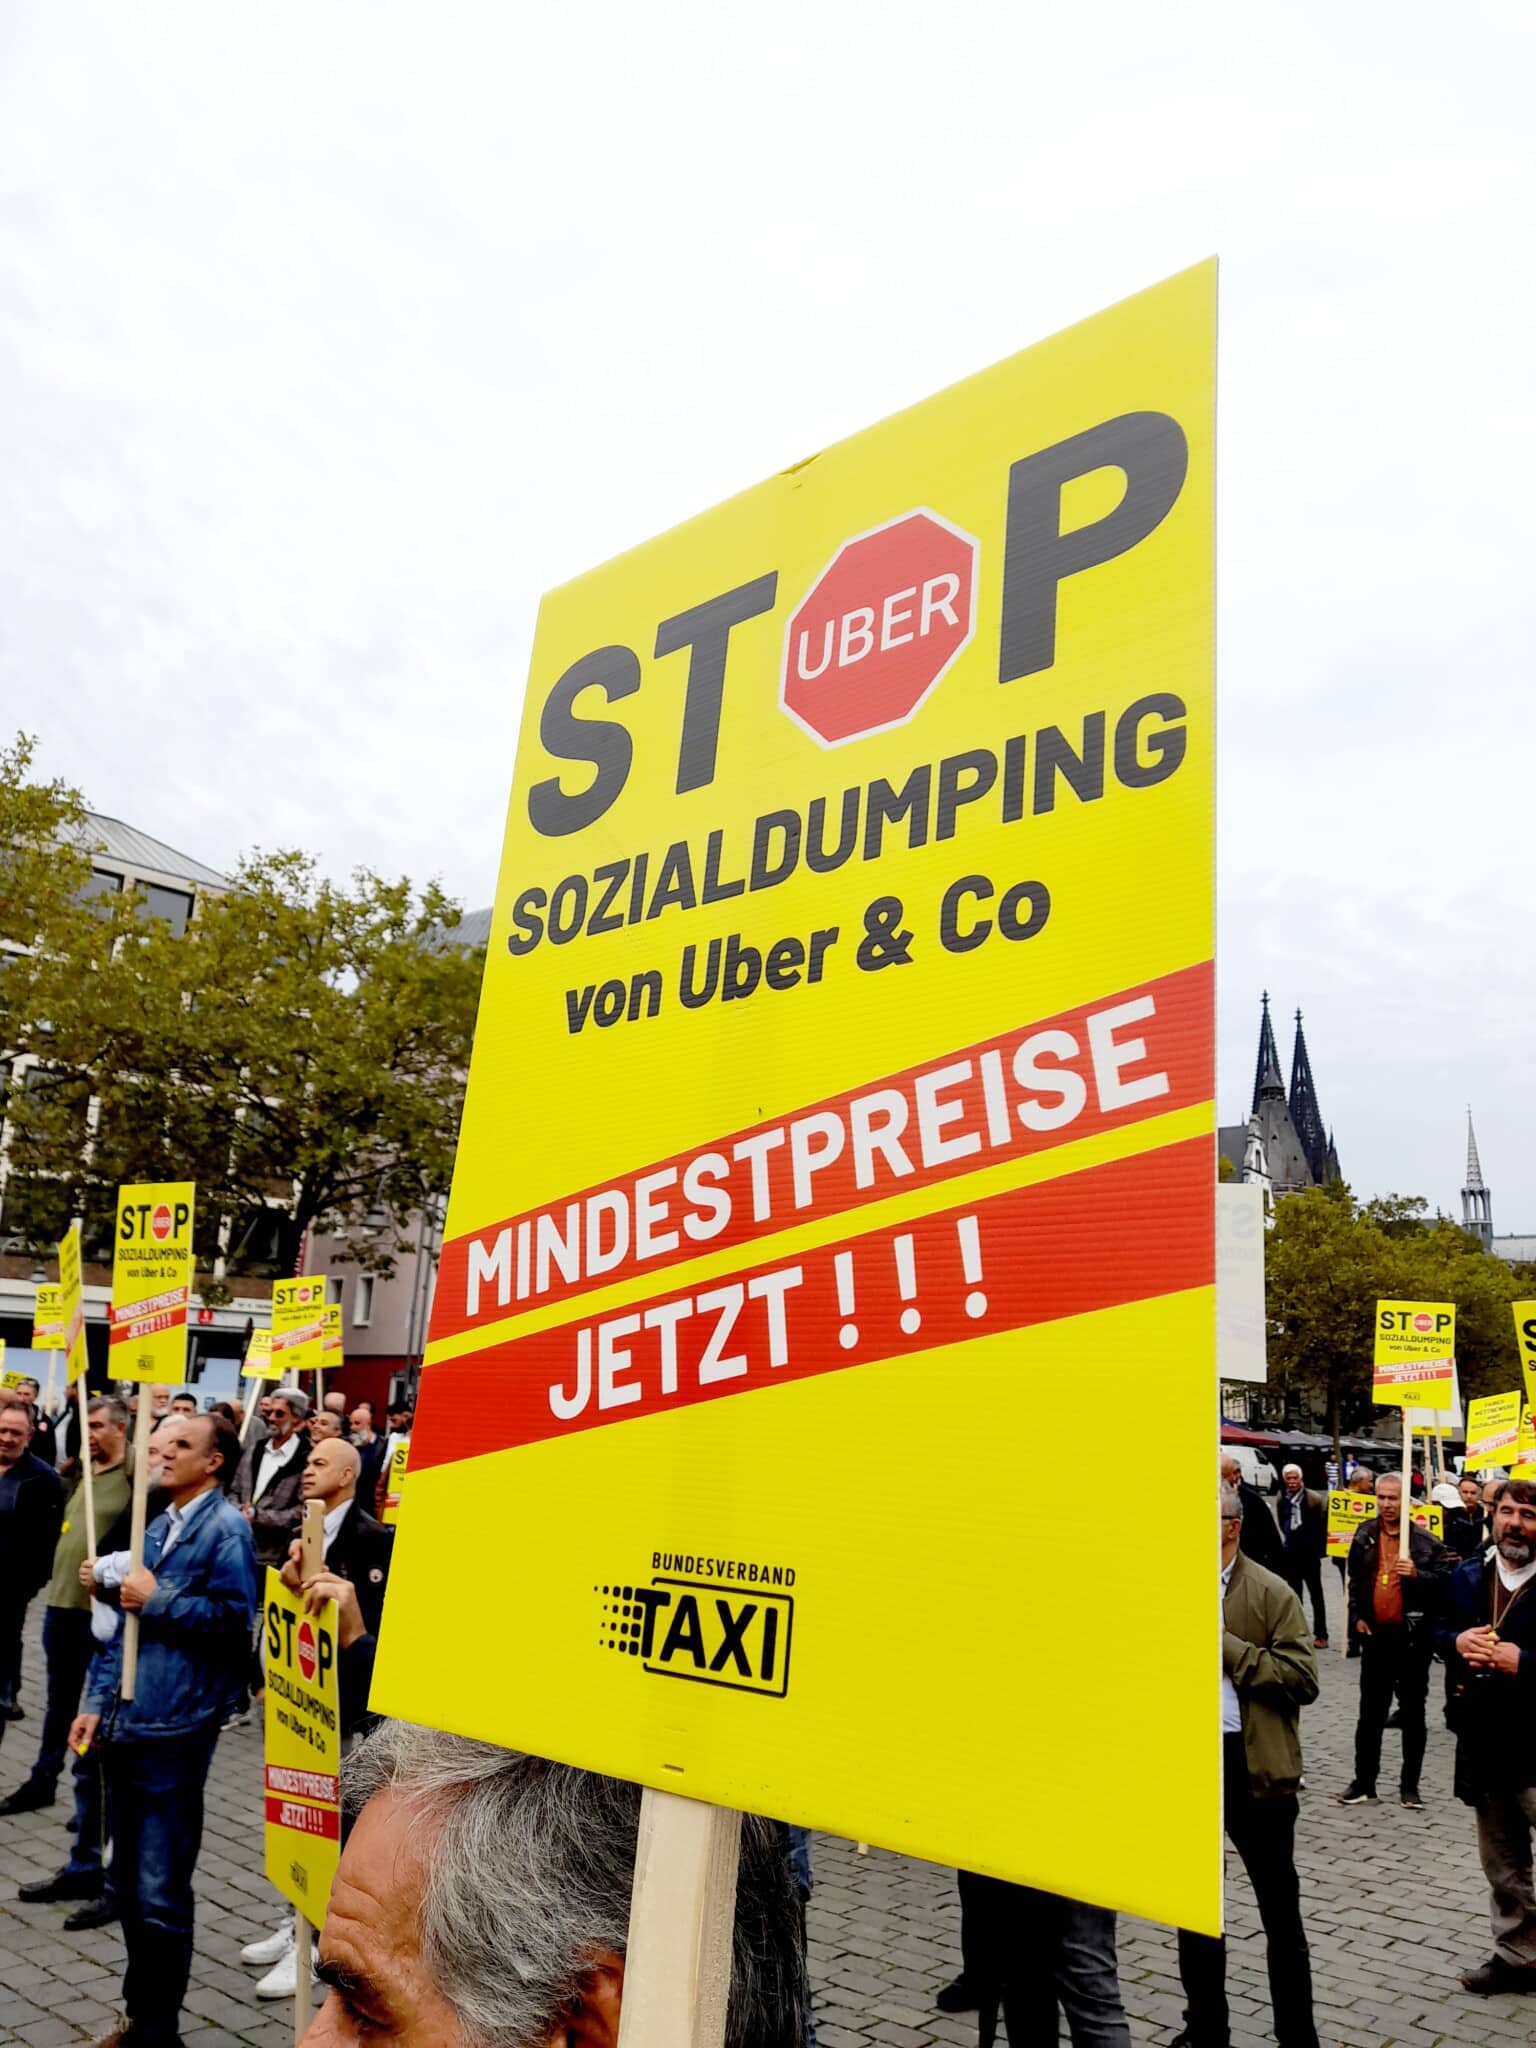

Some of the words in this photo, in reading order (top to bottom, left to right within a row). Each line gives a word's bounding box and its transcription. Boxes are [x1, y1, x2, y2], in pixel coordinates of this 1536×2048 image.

[797, 572, 961, 680] UBER
[507, 693, 1188, 956] SOZIALDUMPING
[565, 970, 663, 1034] von
[679, 926, 840, 1009] Uber
[856, 895, 914, 973] &
[940, 874, 1051, 953] Co
[466, 995, 1169, 1317] MINDESTPREISE
[119, 1248, 188, 1261] SOZIALDUMPING
[549, 1265, 803, 1420] JETZT
[1379, 1334, 1452, 1345] SOZIALDUMPING
[652, 1552, 796, 1587] BUNDESVERBAND
[634, 1587, 779, 1682] TAXI
[268, 1669, 335, 1731] SOZIALDUMPING
[268, 1766, 337, 1802] MINDESTPREISE
